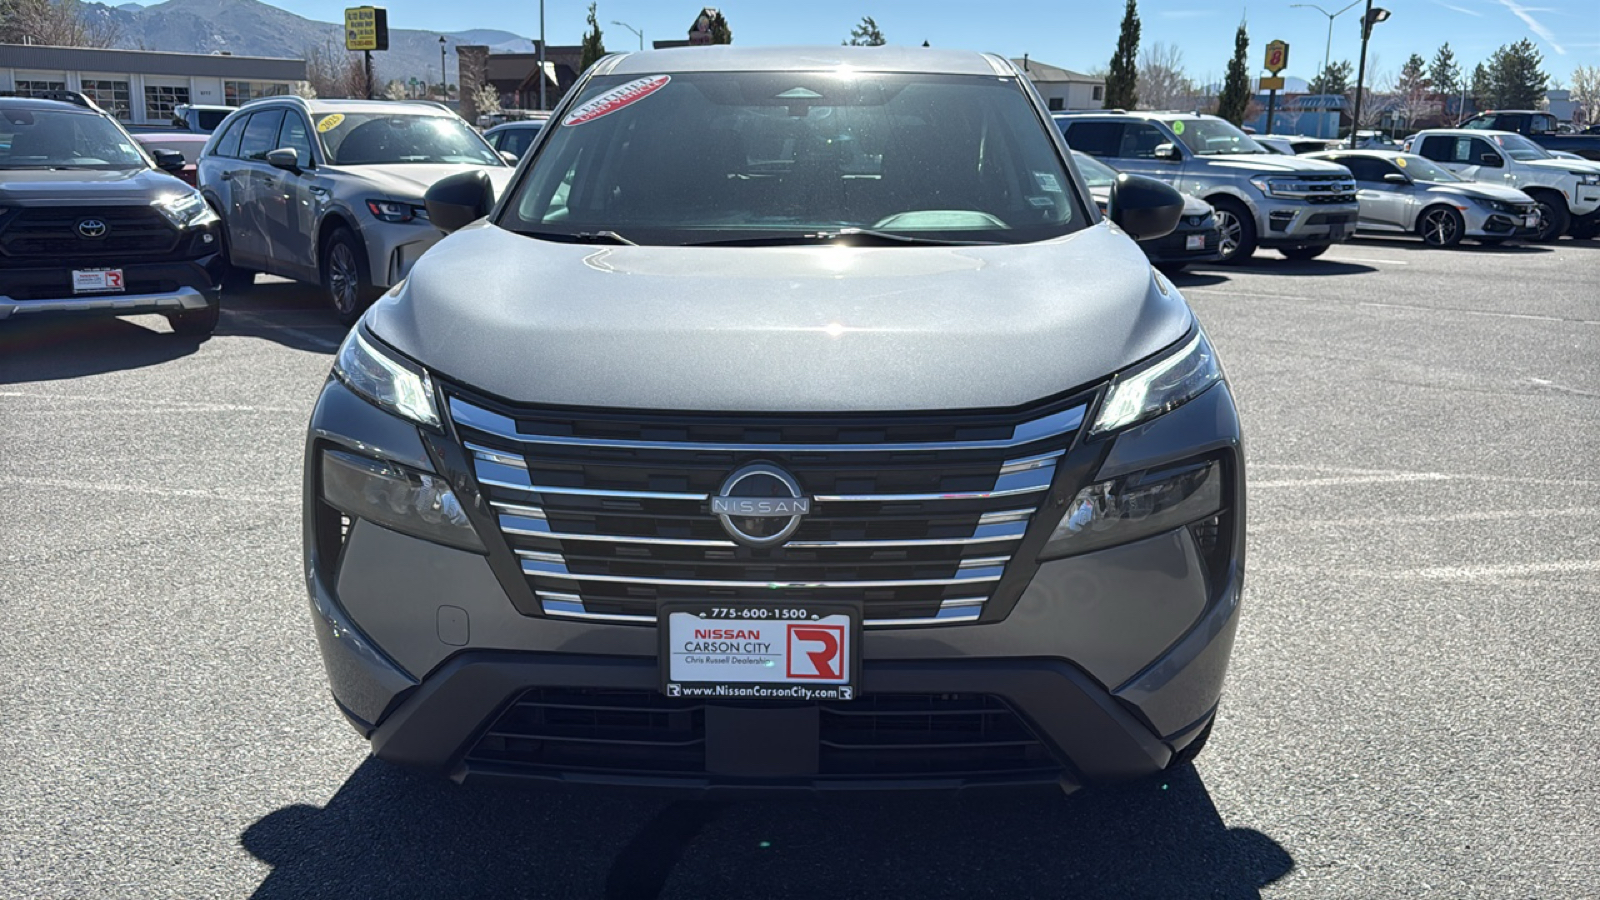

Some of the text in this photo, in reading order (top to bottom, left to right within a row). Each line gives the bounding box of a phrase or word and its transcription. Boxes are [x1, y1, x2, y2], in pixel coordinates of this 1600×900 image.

[570, 77, 654, 118] CERTIFIED
[580, 101, 611, 120] USED
[714, 499, 807, 512] NISSAN
[711, 608, 807, 619] 775-600-1500
[694, 629, 760, 640] NISSAN
[684, 641, 771, 653] CARSON CITY
[685, 655, 704, 664] Chris
[706, 655, 730, 665] Russell
[682, 685, 837, 700] www.NissanCarsonCity.com
